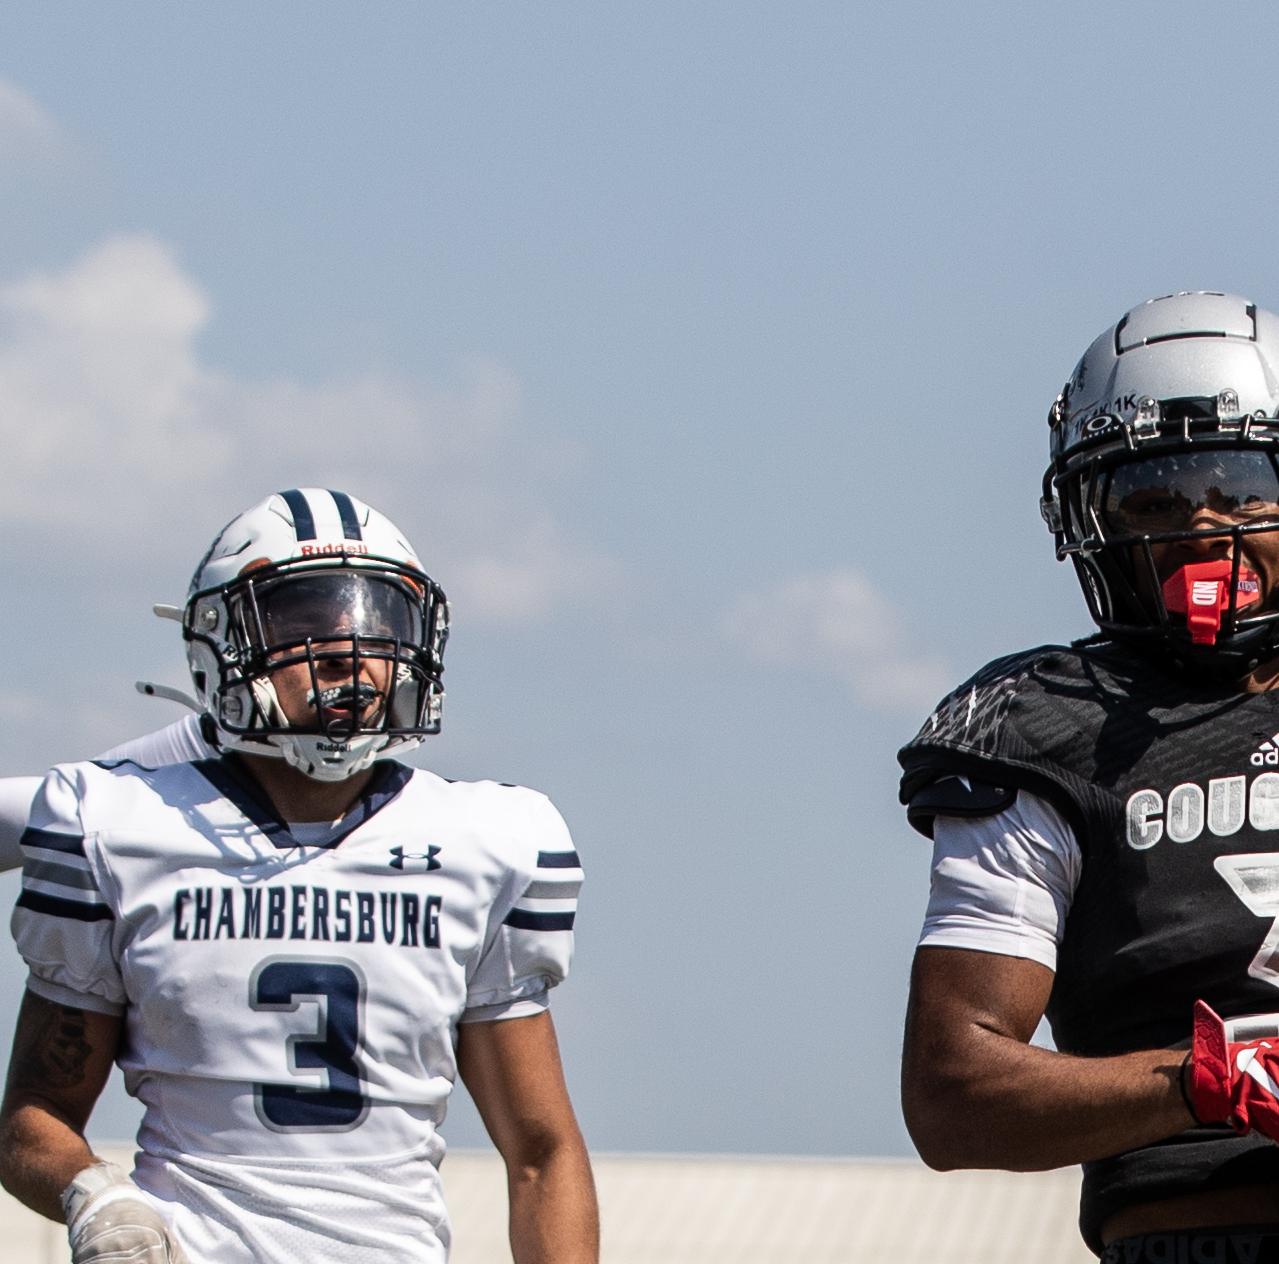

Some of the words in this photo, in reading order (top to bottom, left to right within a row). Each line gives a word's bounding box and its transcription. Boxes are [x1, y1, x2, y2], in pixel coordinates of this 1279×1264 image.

[1115, 394, 1137, 413] 1K
[301, 543, 369, 556] Riddell
[173, 884, 444, 949] CHAMBERSBURG
[248, 953, 371, 1134] 3
